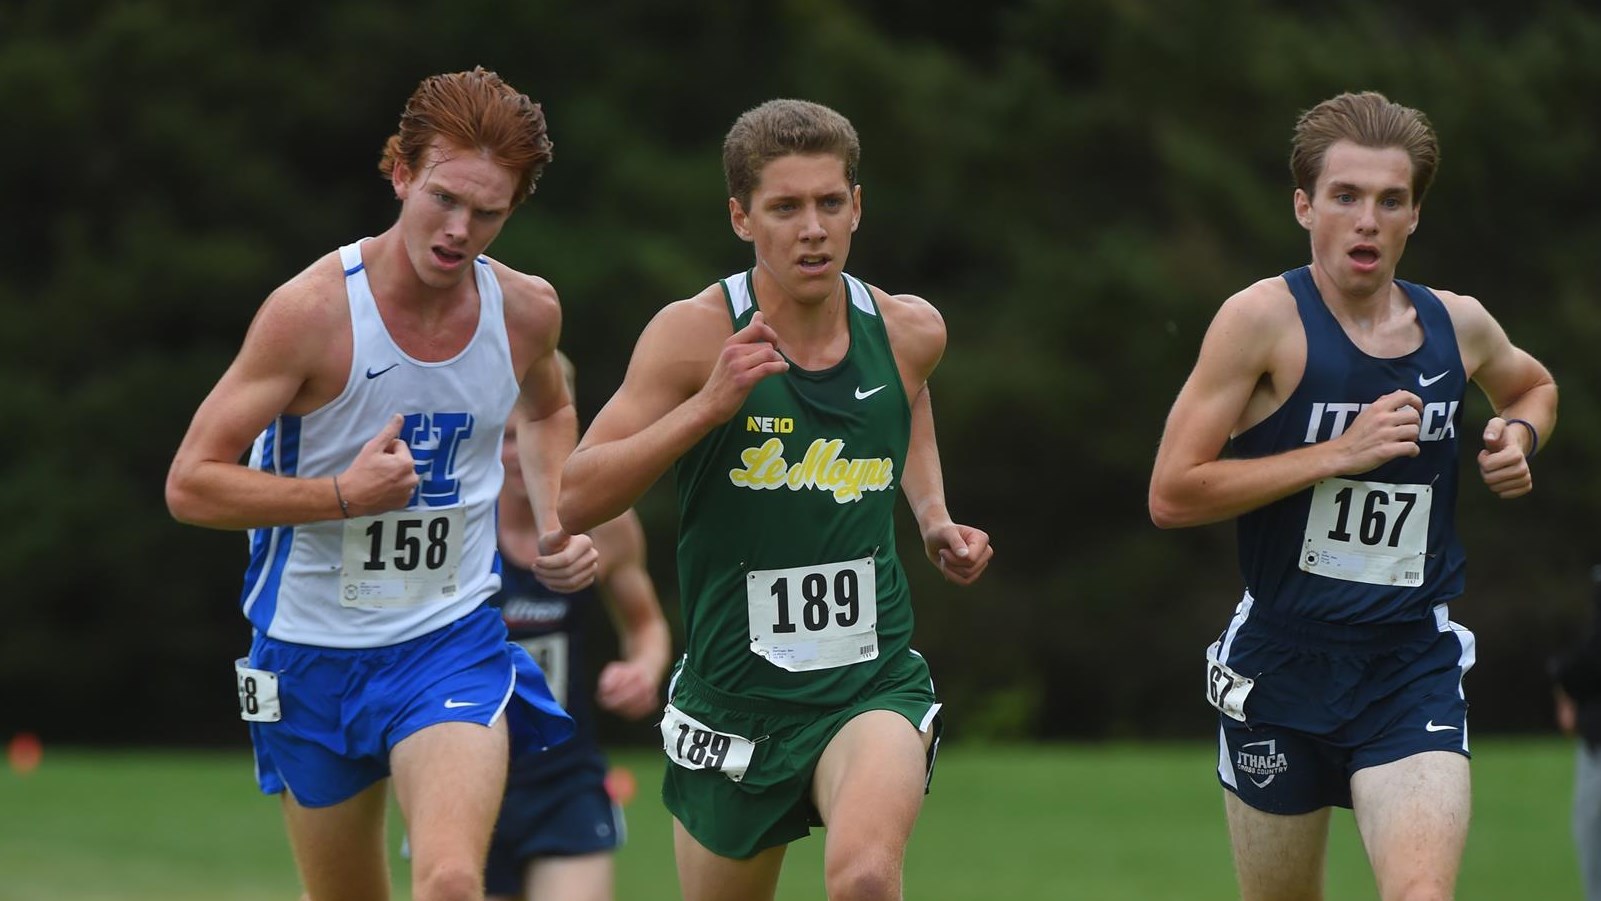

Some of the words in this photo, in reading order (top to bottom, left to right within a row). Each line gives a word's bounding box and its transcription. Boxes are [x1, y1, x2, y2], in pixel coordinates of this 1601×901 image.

[746, 416, 794, 433] NE10
[1304, 401, 1459, 443] ITCA
[729, 437, 788, 490] Le
[787, 438, 894, 504] Moyne
[1327, 486, 1416, 548] 167
[364, 516, 450, 571] 158
[770, 569, 859, 634] 189
[676, 723, 731, 770] 189
[1237, 751, 1288, 769] ITHACA
